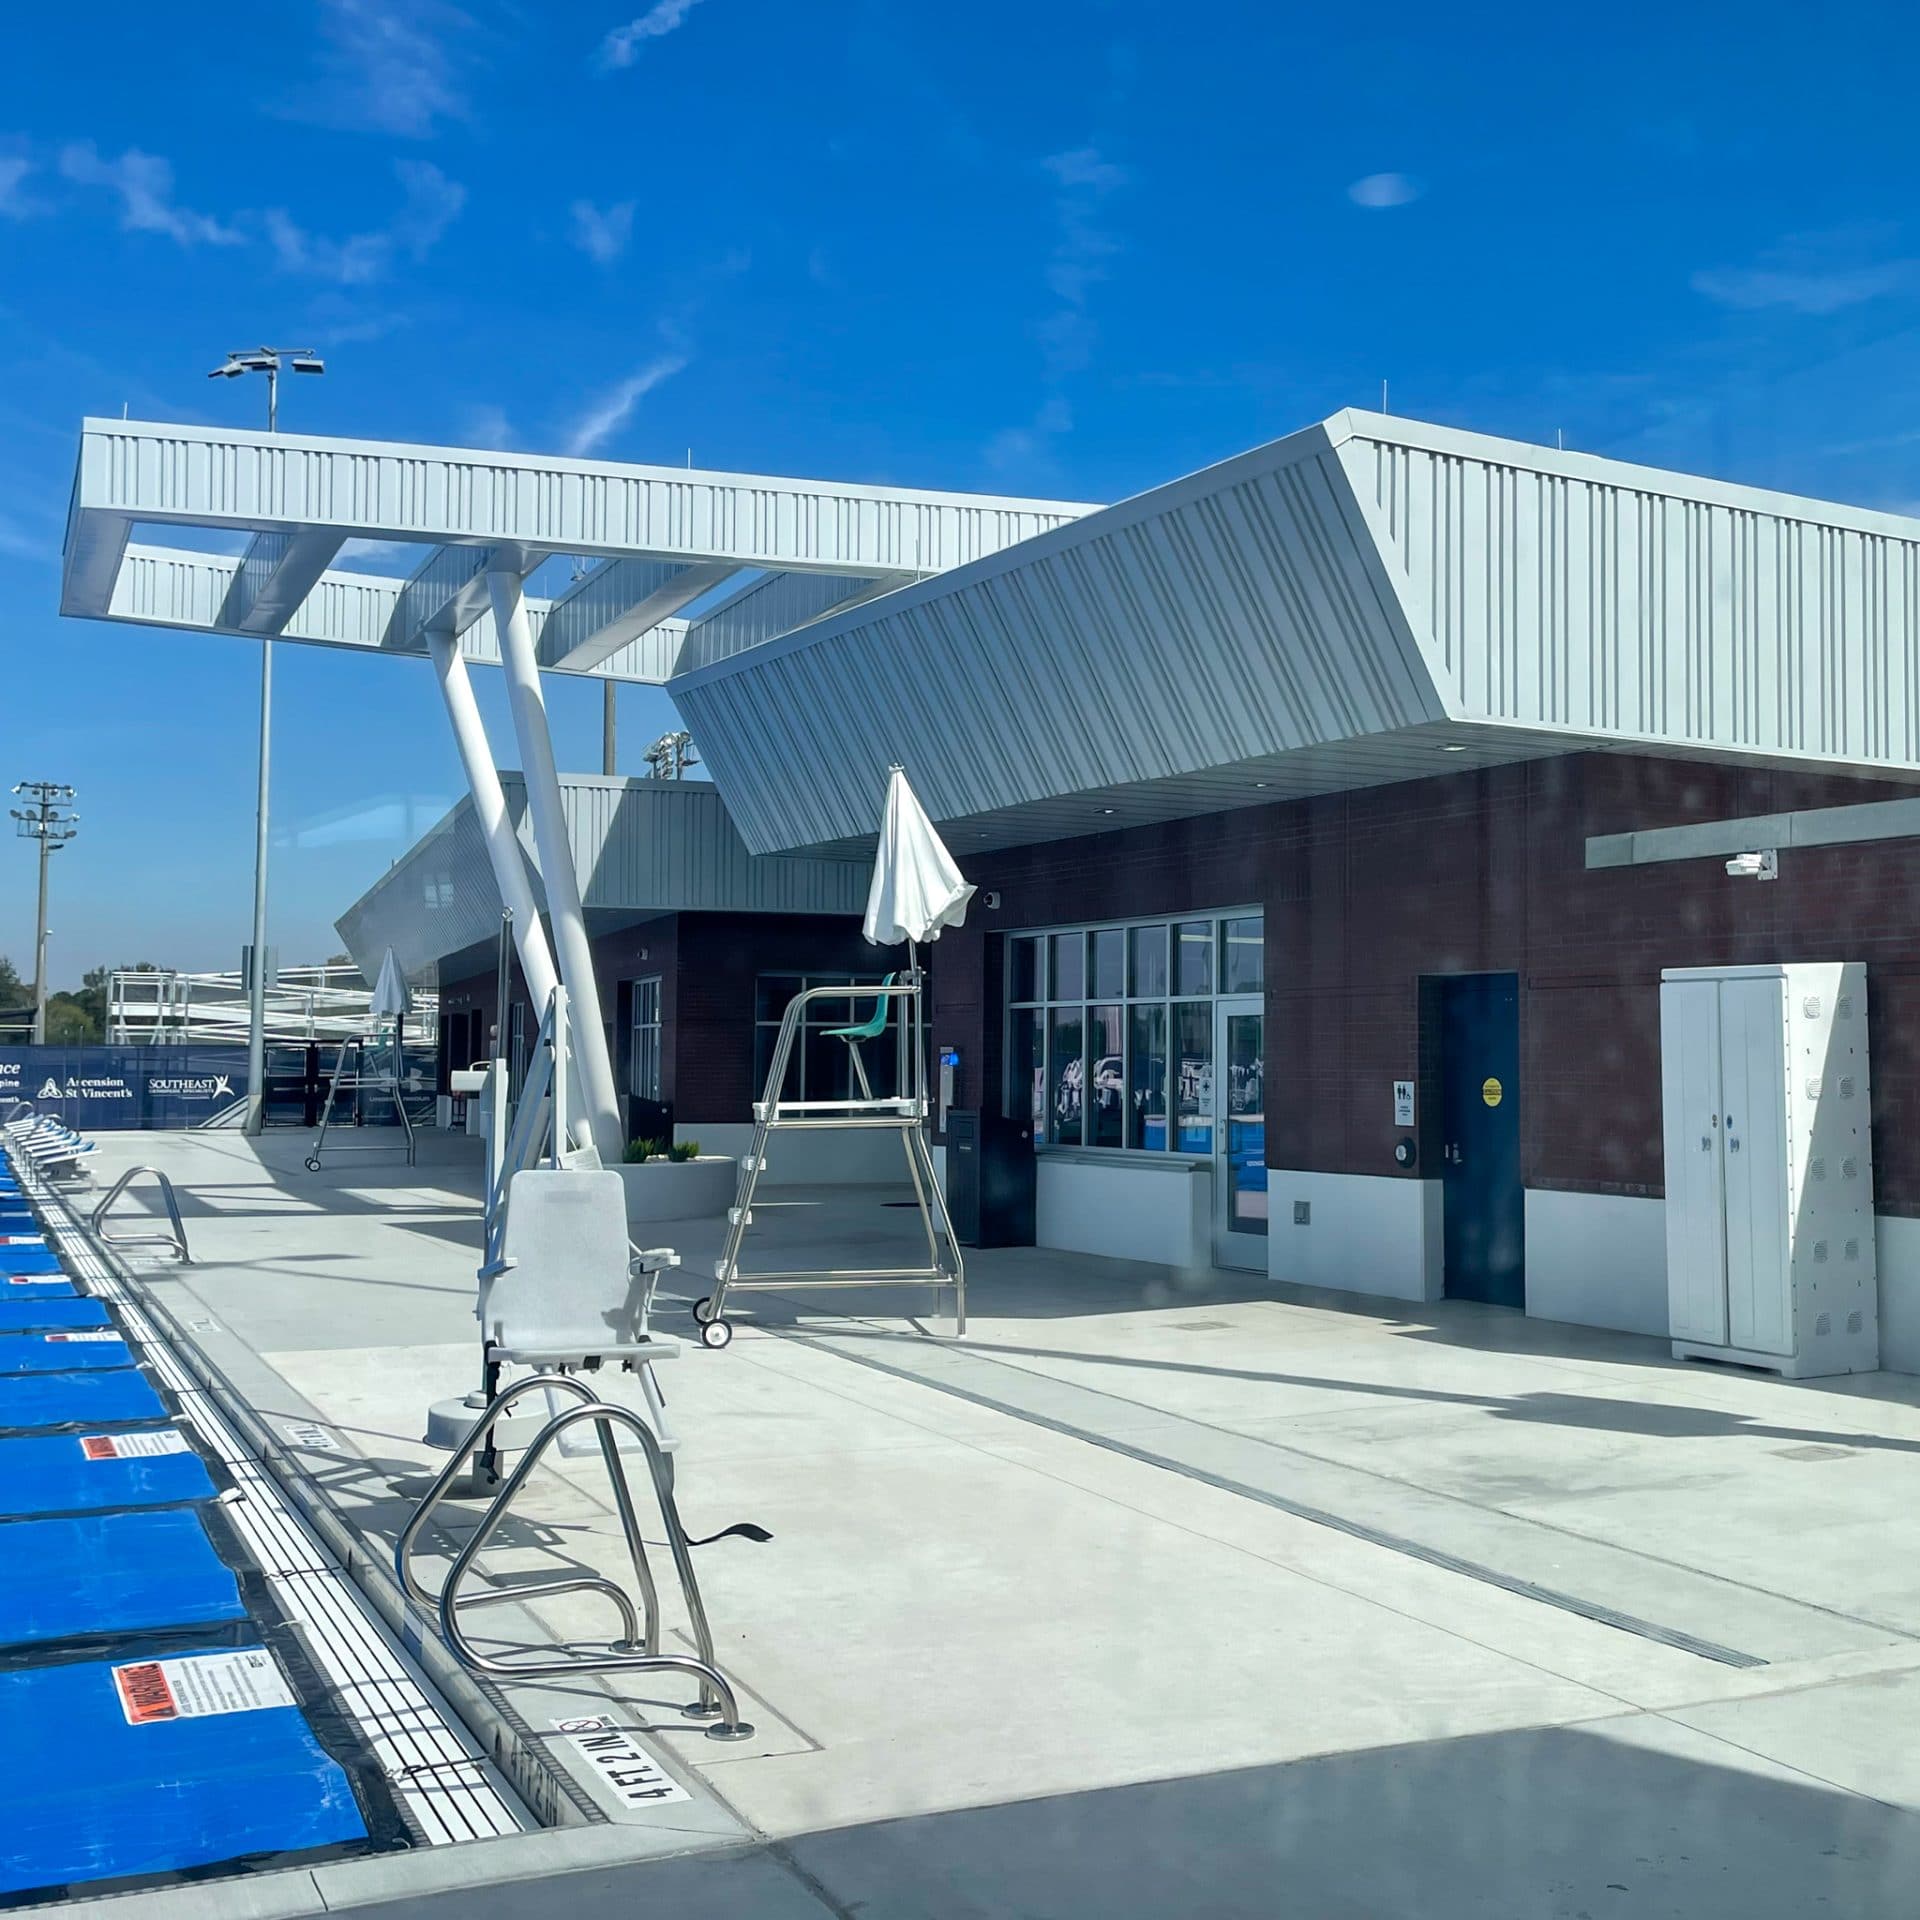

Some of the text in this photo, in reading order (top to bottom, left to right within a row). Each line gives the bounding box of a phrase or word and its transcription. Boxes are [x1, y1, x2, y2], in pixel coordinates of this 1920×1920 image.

[81, 1088, 133, 1098] Vincent's
[123, 1663, 168, 1708] WARNING
[596, 1752, 641, 1764] 2
[628, 1788, 673, 1799] 4
